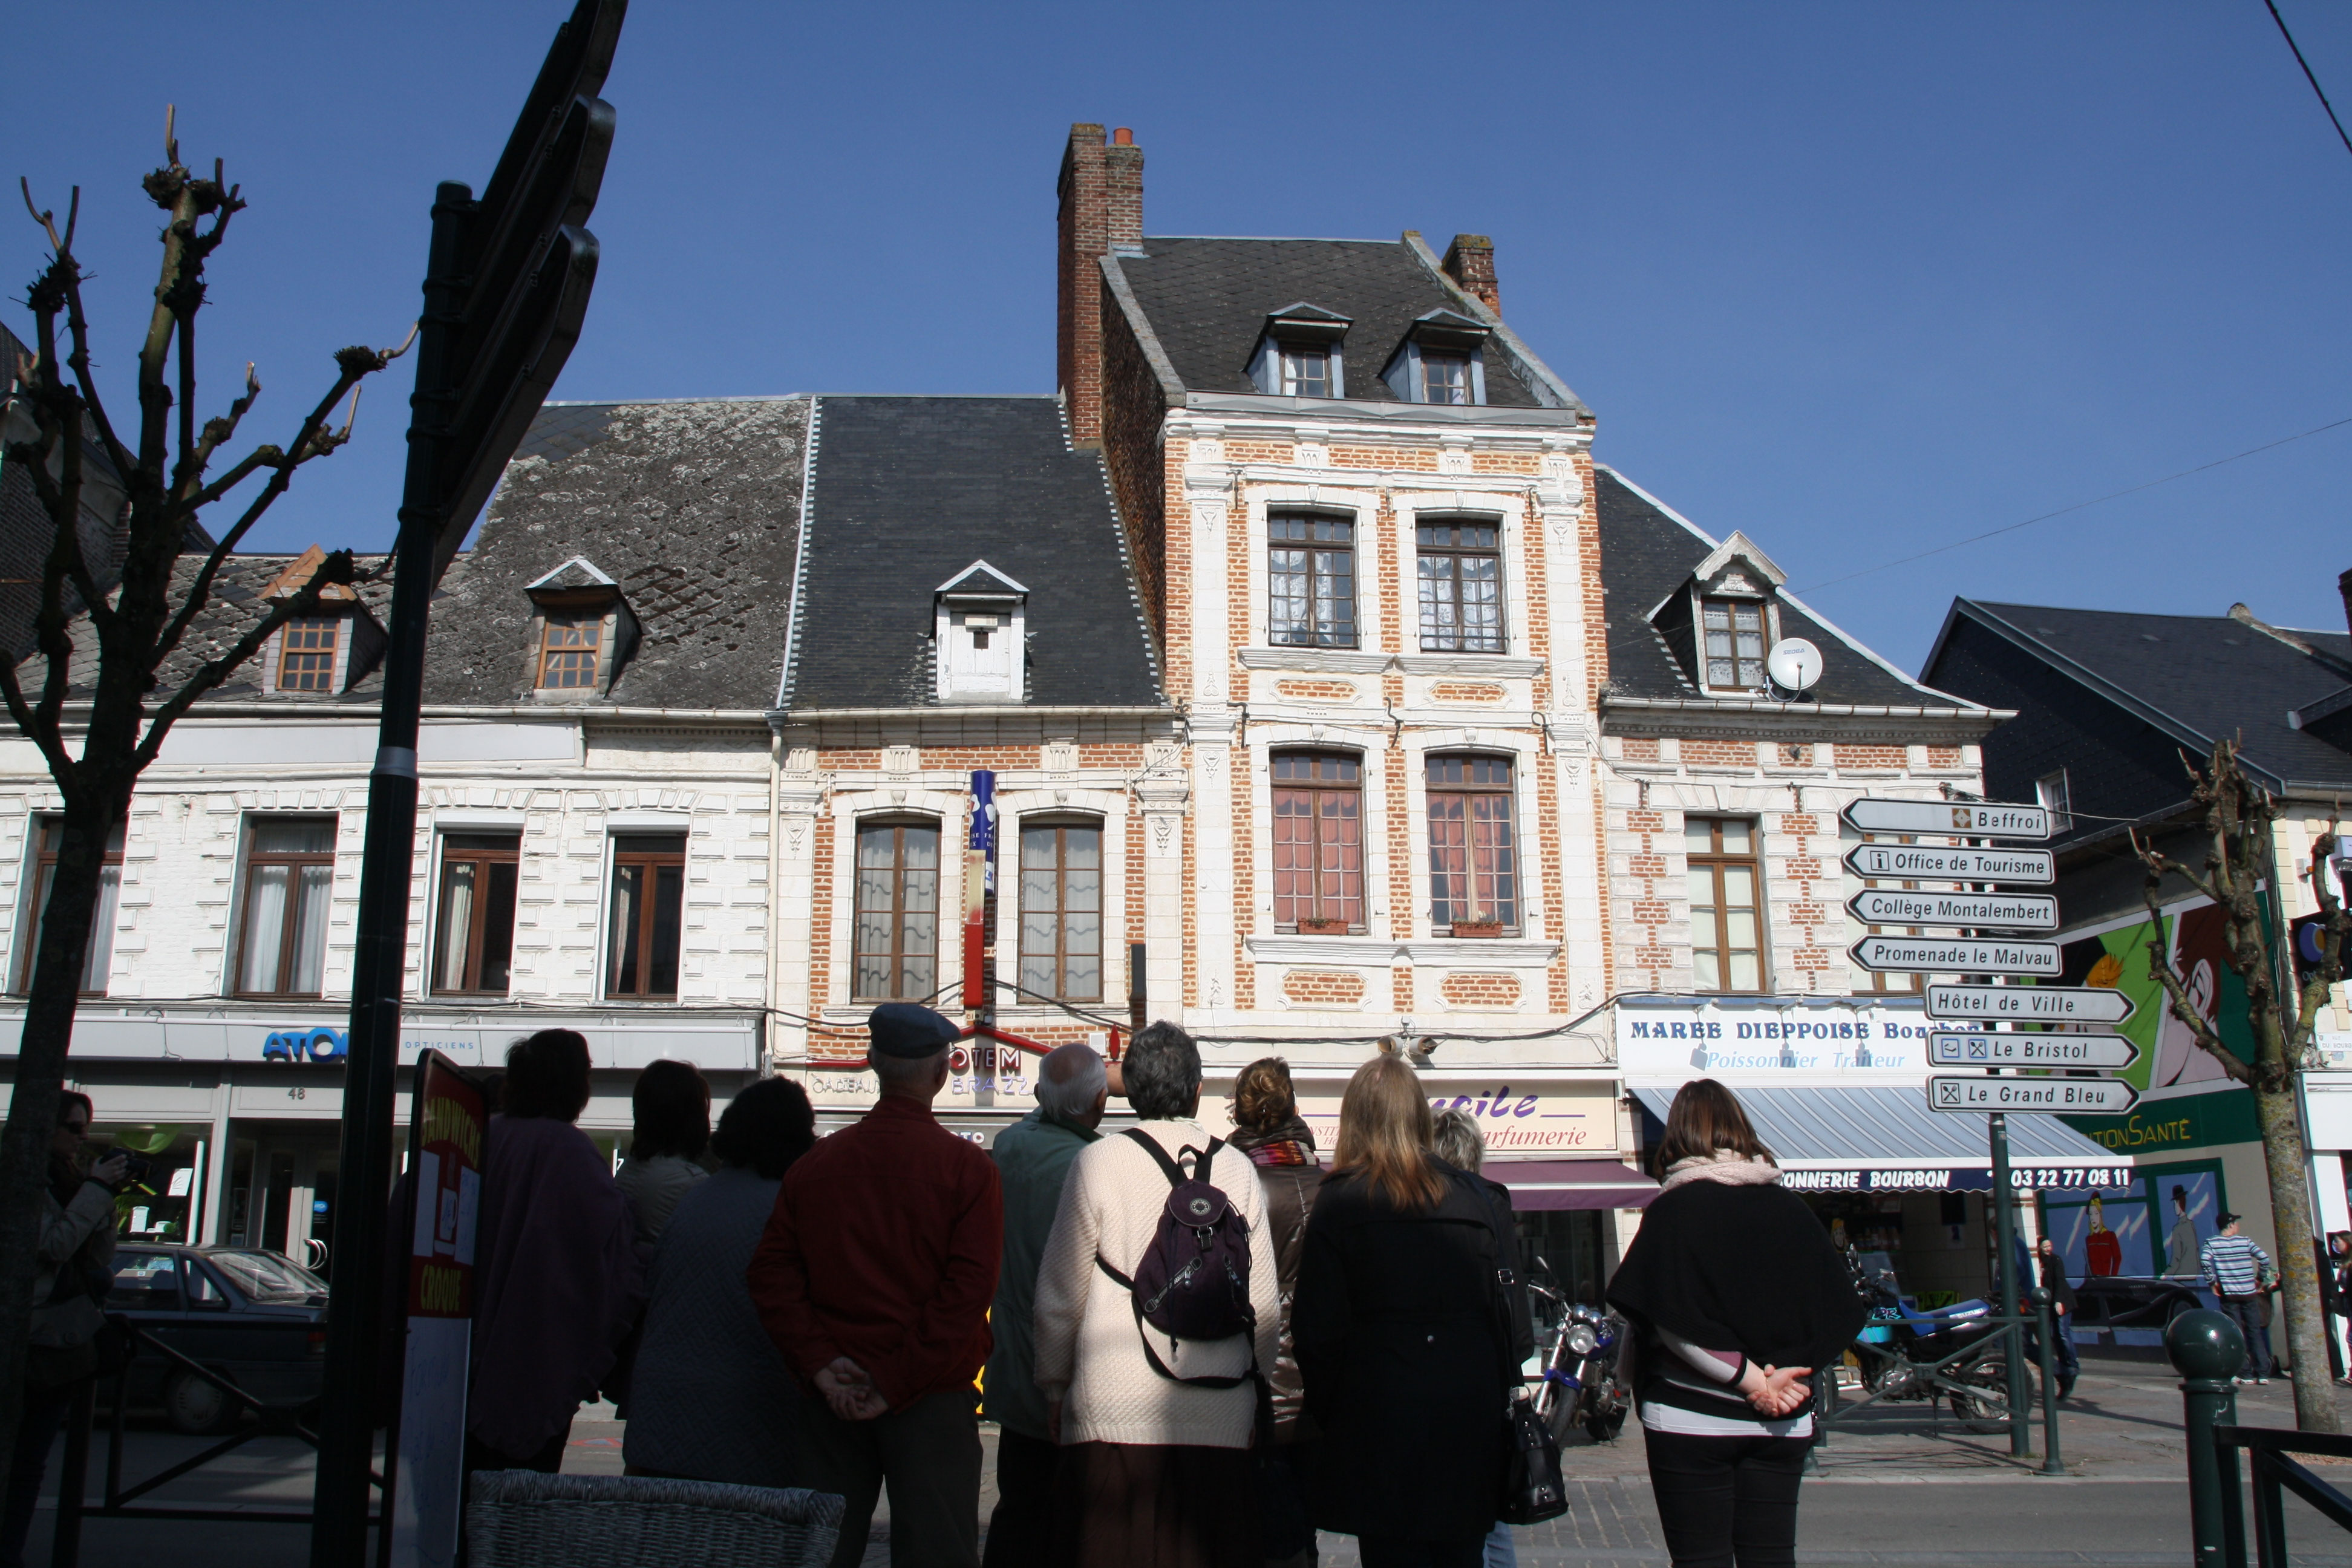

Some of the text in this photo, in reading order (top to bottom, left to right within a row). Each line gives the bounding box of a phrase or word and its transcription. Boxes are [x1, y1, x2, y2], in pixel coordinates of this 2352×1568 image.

[1978, 812, 2040, 829] Beffroi
[1895, 853, 2045, 874] Office de Tourisme
[1872, 898, 2049, 920] Collège Montalembert
[1874, 945, 2053, 965] Promenade le Malvau
[1938, 993, 2074, 1012] Hôtel de Ville
[1737, 1022, 1870, 1040] DIEPPOISE
[405, 1041, 474, 1050] OPTICIENS
[1994, 1042, 2088, 1058] Le Bristol
[949, 1047, 1021, 1070] OTEM
[1707, 1051, 1905, 1068] Poissonnier Traiteur
[287, 1087, 305, 1100] 48
[952, 1076, 1034, 1094] BRAZZ
[1968, 1086, 2105, 1103] Le Grand Bleu
[422, 1097, 482, 1169] SANDWICHS
[1482, 1125, 1587, 1149] arfumerie
[1780, 1168, 2129, 1188] ONNERIE BOURBON 03 22 77 08 11
[420, 1264, 462, 1315] CROQUE
[1956, 1307, 1984, 1319] SUZUKI
